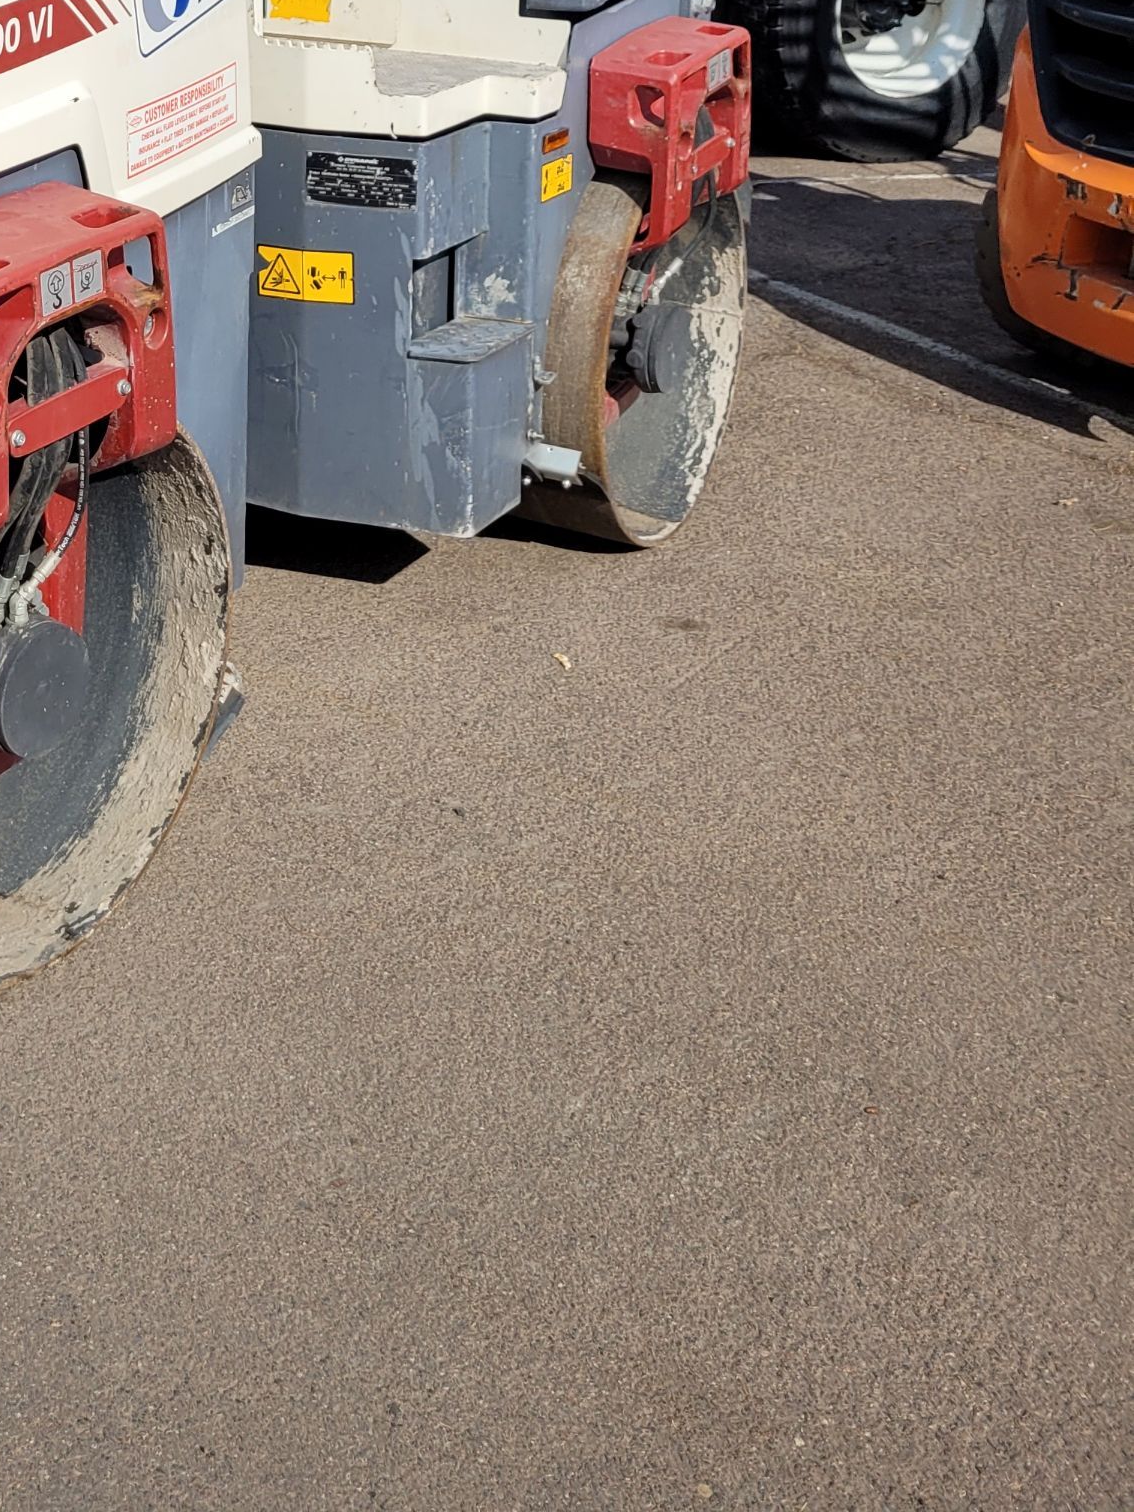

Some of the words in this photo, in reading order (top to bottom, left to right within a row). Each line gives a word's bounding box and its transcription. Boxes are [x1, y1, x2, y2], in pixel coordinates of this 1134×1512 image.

[29, 4, 55, 45] VI
[144, 96, 179, 125] CUSTOMER
[180, 75, 225, 107] RESPONSIBILITY
